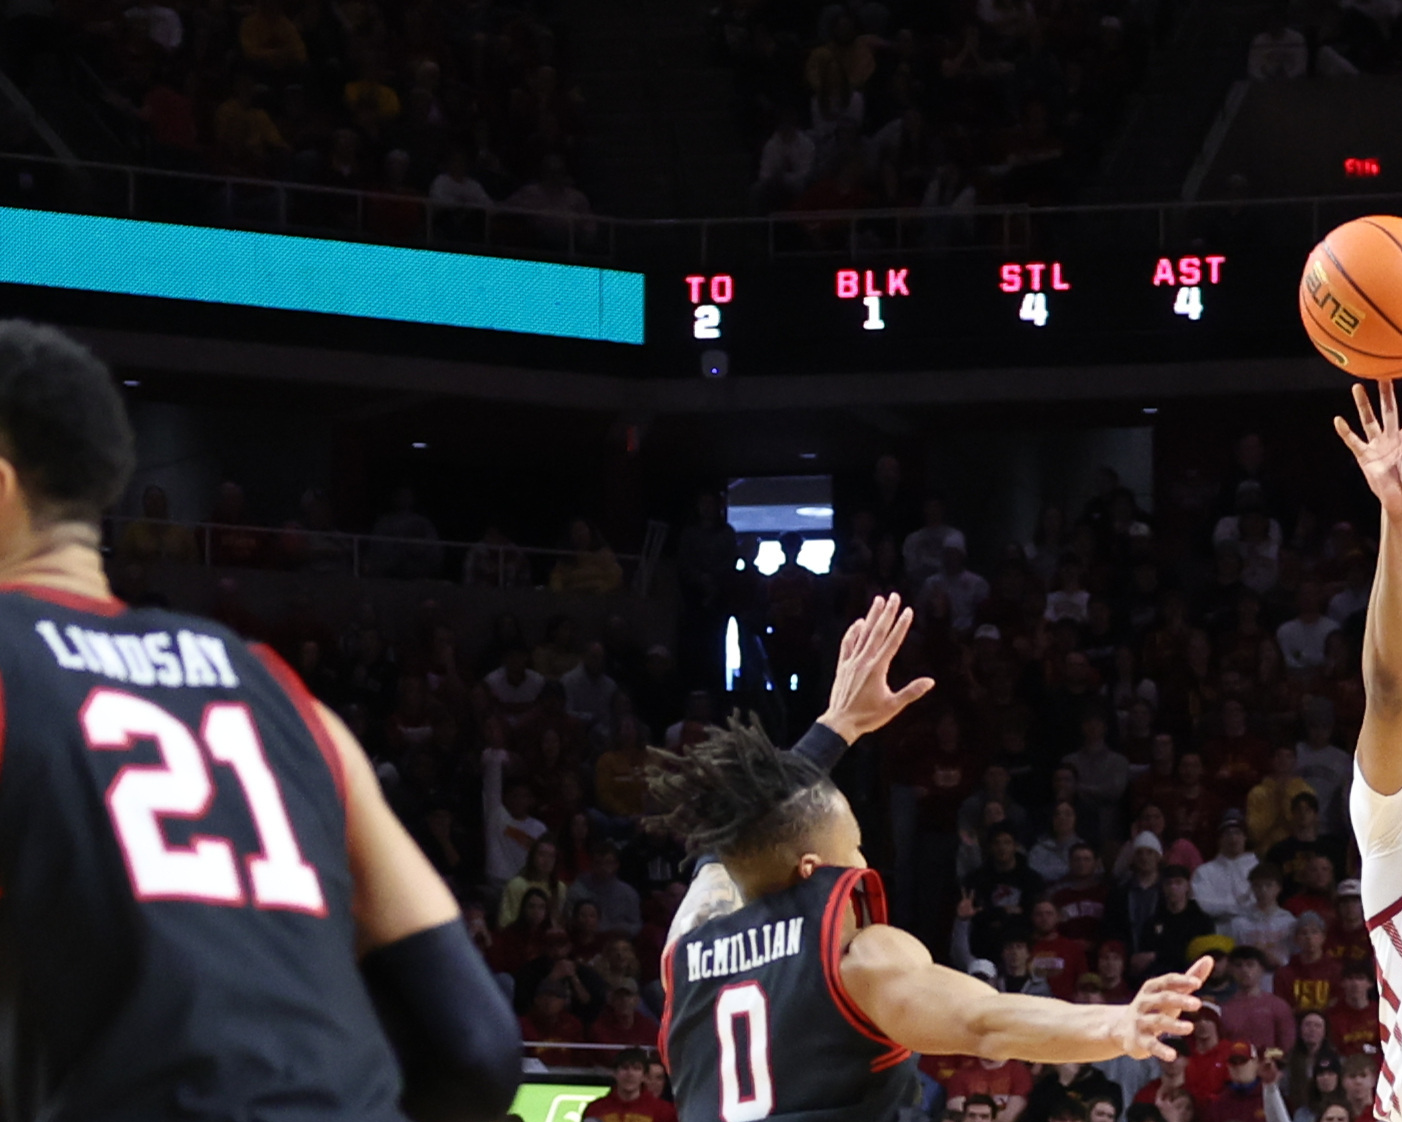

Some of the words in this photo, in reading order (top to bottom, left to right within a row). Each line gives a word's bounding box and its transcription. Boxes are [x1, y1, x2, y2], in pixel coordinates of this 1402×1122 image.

[836, 269, 909, 298] BLK
[1000, 262, 1070, 292] STL
[1153, 256, 1225, 287] AST
[686, 275, 733, 303] TO
[1173, 287, 1202, 320] 4
[693, 306, 721, 339] 2
[862, 297, 885, 330] 1
[1019, 293, 1047, 326] 4
[35, 620, 240, 689] LINDSAY
[78, 686, 329, 919] 21
[686, 916, 804, 982] McMILLIAN
